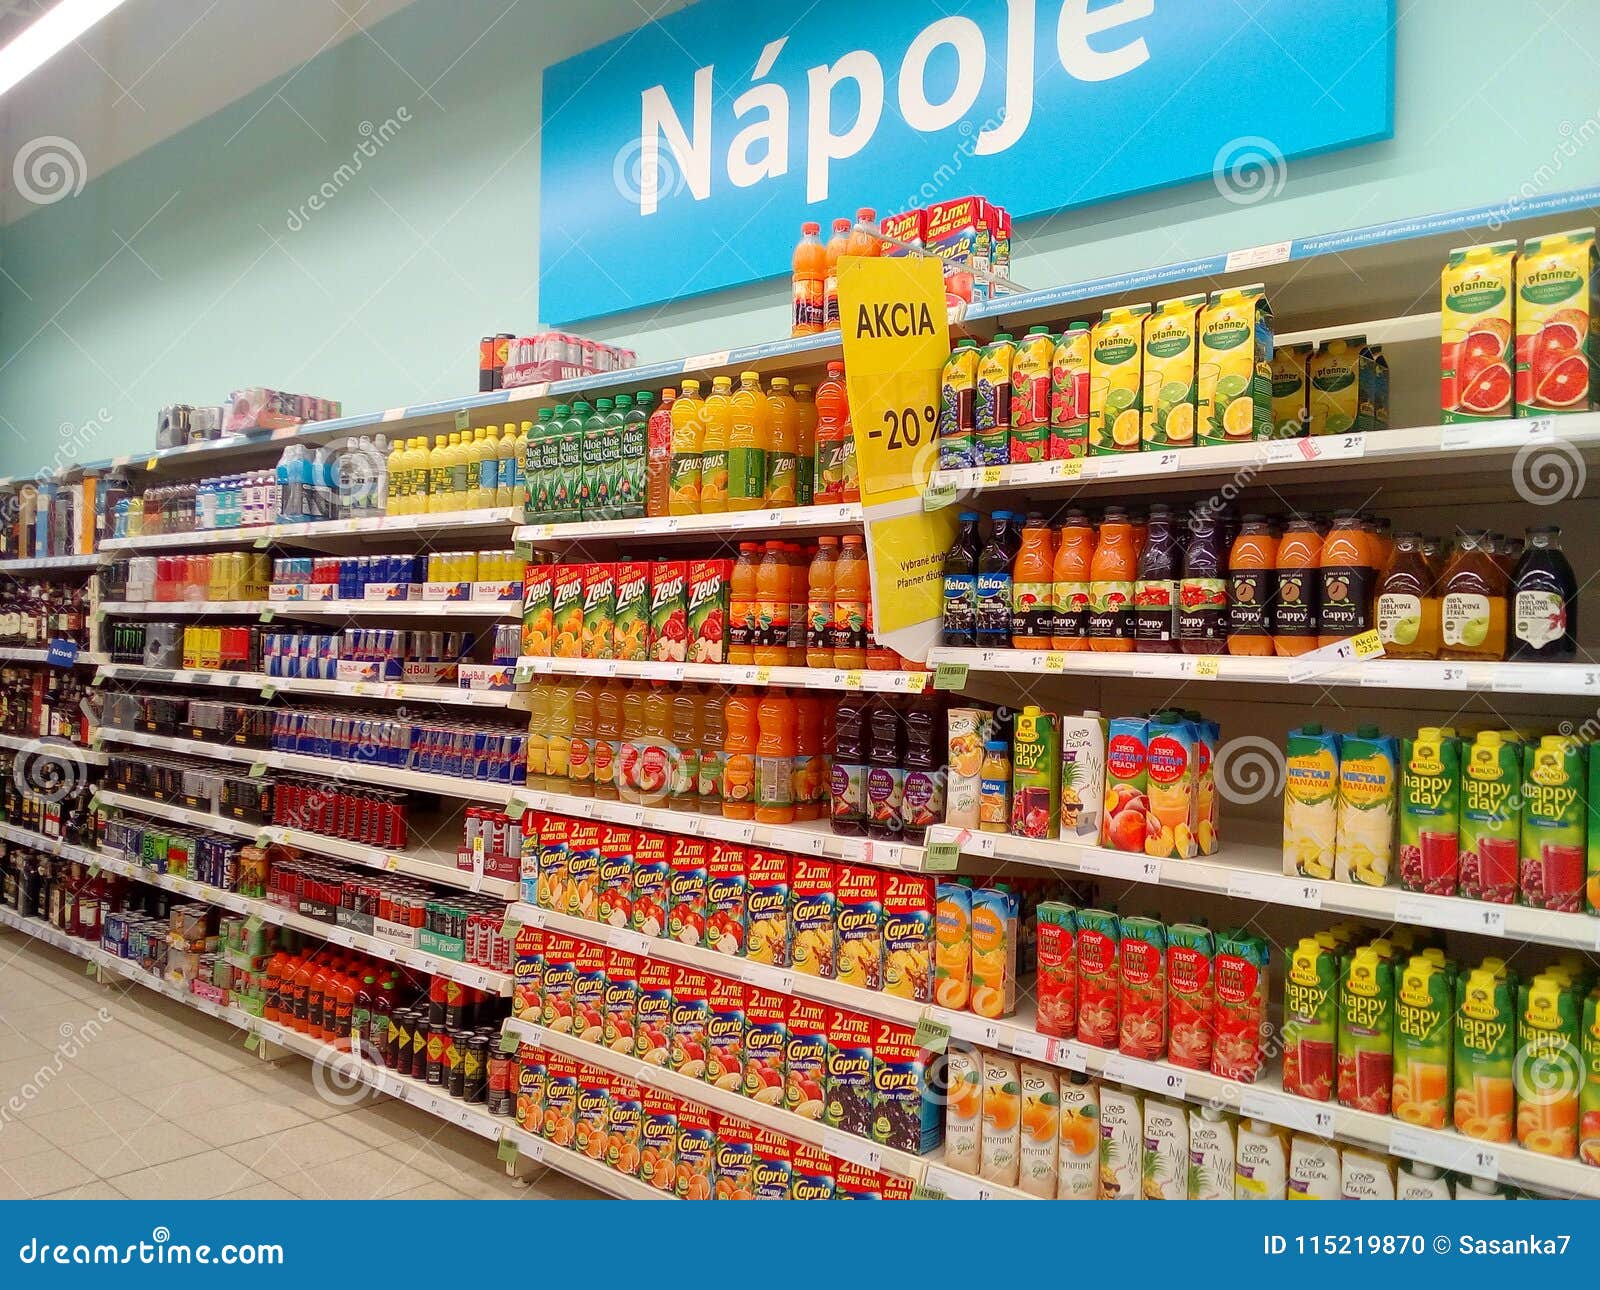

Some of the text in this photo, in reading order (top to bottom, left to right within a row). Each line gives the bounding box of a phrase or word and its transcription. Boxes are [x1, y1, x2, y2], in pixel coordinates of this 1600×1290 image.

[640, 0, 1155, 216] Nápoje
[943, 200, 971, 223] LITRY
[951, 216, 972, 231] CENA
[1528, 269, 1577, 284] pfanner
[1453, 280, 1499, 295] pfanner
[857, 302, 935, 338] AKCIA
[1209, 320, 1247, 333] pfanner
[1099, 336, 1133, 349] pfanner
[1152, 329, 1186, 341] pfanner
[678, 455, 702, 472] Zeus
[897, 576, 924, 590] Pfanner
[944, 578, 970, 590] Relax
[978, 578, 1005, 589] Relax
[524, 579, 551, 610] Zeus
[554, 578, 582, 610] Zeus
[584, 577, 614, 609] Zeus
[616, 577, 645, 609] Zeus
[651, 576, 683, 610] Zeus
[689, 575, 721, 610] Zeus
[1052, 616, 1077, 627] Cappy
[1089, 616, 1114, 628] Cappy
[1180, 616, 1204, 627] Cappy
[1231, 610, 1261, 621] Cappy
[1277, 610, 1307, 621] Cappy
[1323, 610, 1355, 621] Cappy
[414, 665, 429, 674] Bull
[1016, 753, 1037, 768] day
[1112, 761, 1136, 770] PEACH
[1152, 764, 1176, 773] PEACH
[1288, 768, 1331, 779] NECTAR
[1289, 777, 1330, 789] BANANA
[1343, 772, 1386, 785] NECTAR
[1403, 773, 1452, 795] happy
[982, 782, 1000, 791] Relax
[1343, 782, 1385, 793] BANANA
[1463, 775, 1511, 800] happy
[1525, 780, 1577, 805] happy
[1410, 789, 1442, 809] day
[1468, 793, 1501, 815] day
[1531, 800, 1566, 821] day
[569, 855, 597, 874] Caprio
[601, 863, 630, 880] Caprio
[762, 858, 784, 871] LITRY
[749, 872, 786, 881] SUPER CENA
[851, 875, 874, 887] LITRY
[838, 889, 877, 897] SUPER CENA
[898, 883, 924, 895] LITRY
[749, 891, 784, 912] Caprio
[884, 898, 925, 906] SUPER CENA
[838, 910, 877, 930] Caprio
[884, 918, 924, 941] Caprio
[1039, 952, 1062, 962] TOMATO
[1081, 960, 1104, 969] TOMATO
[1123, 969, 1149, 980] TOMATO
[1285, 979, 1327, 1003] happy
[761, 997, 783, 1008] LITRY
[1341, 988, 1387, 1013] happy
[747, 1008, 784, 1018] SUPER CENA
[1290, 999, 1318, 1019] day
[1395, 1000, 1440, 1026] happy
[1347, 1007, 1377, 1027] day
[843, 1021, 869, 1032] LITRE
[1401, 1018, 1431, 1041] day
[1456, 1013, 1506, 1039] happy
[746, 1028, 783, 1049] Caprio
[829, 1032, 870, 1044] SUPER CENA
[829, 1054, 869, 1075] Caprio
[874, 1068, 918, 1091] Caprio
[754, 1143, 773, 1153] SUPER
[753, 1164, 789, 1185] Caprio
